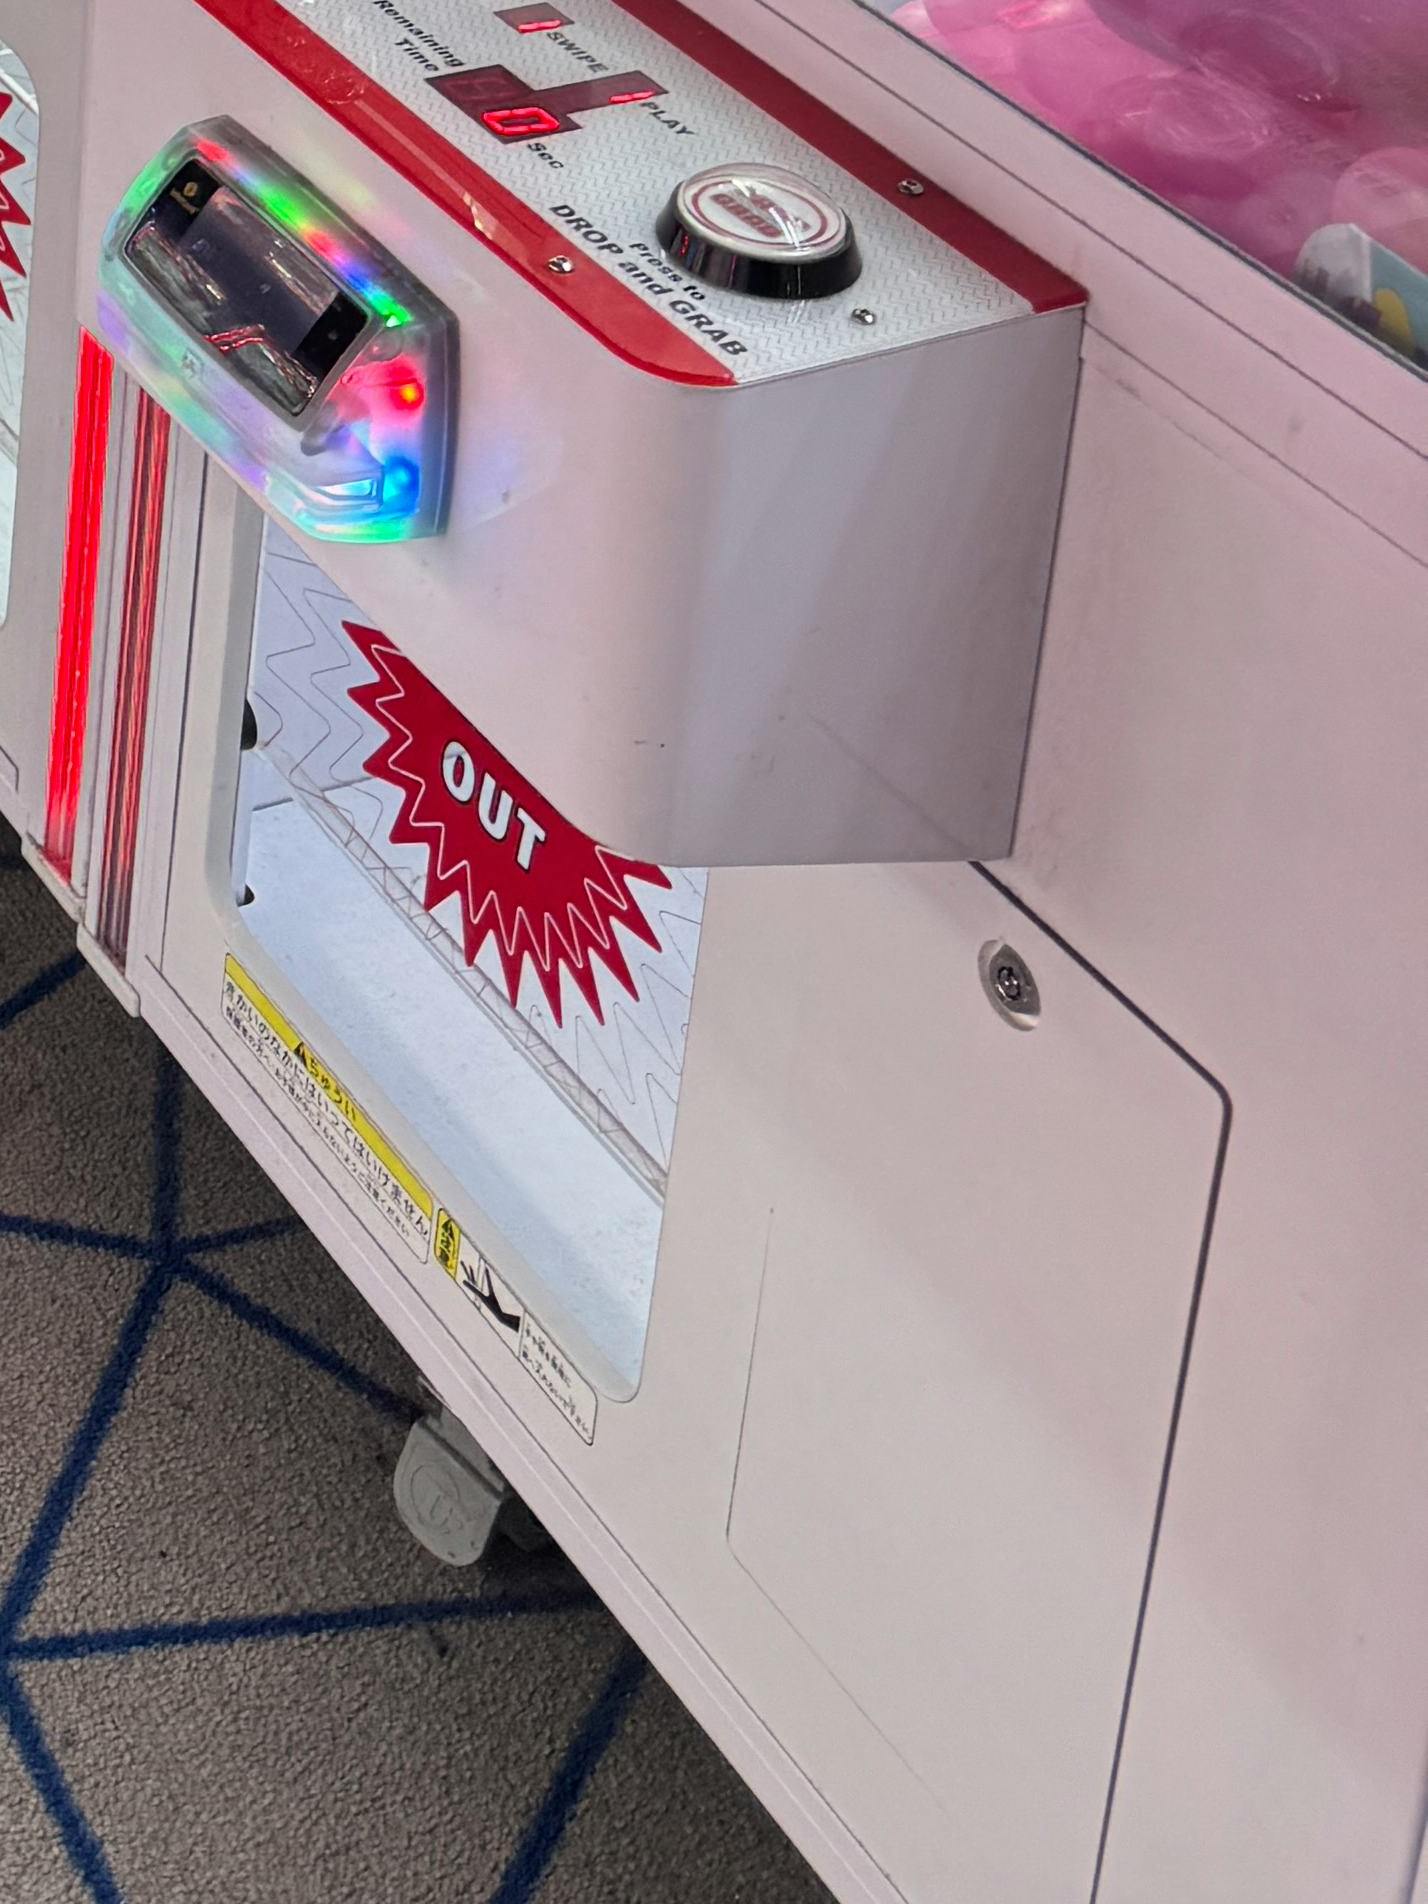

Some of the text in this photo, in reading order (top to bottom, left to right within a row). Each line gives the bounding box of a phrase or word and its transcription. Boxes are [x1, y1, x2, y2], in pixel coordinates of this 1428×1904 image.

[394, 38, 441, 73] Time
[546, 31, 609, 74] SWIPE
[640, 101, 696, 138] PLAY
[527, 142, 565, 170] Sec
[549, 204, 749, 357] DROP and GRAB
[629, 242, 707, 302] Press to
[440, 739, 547, 873] OUT
